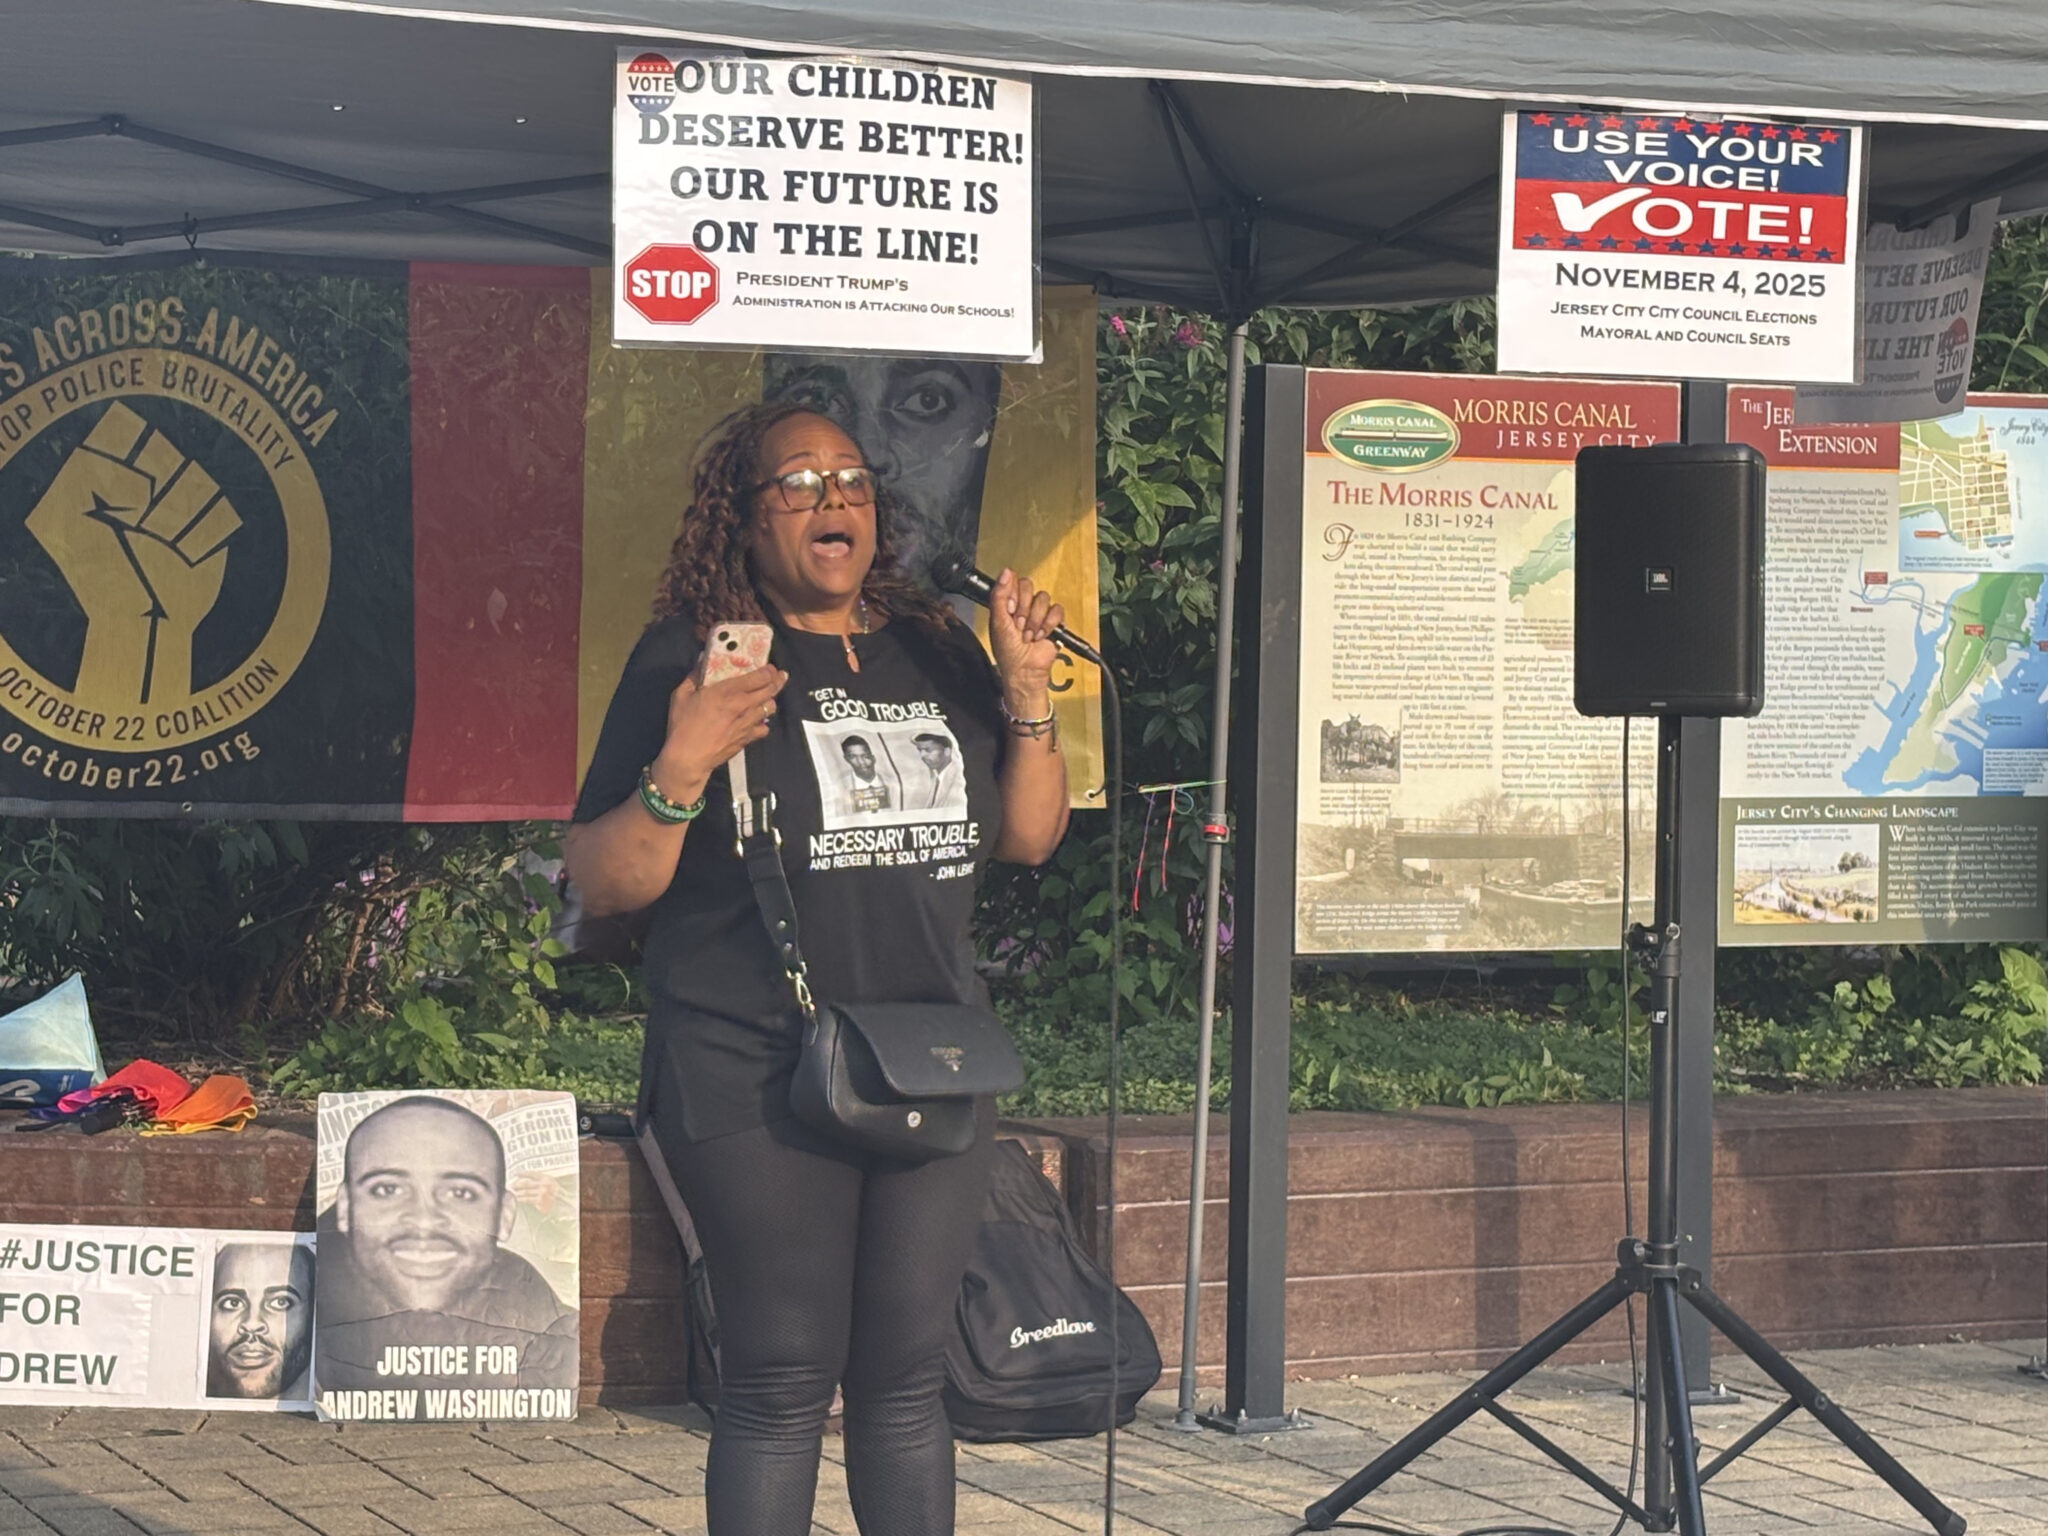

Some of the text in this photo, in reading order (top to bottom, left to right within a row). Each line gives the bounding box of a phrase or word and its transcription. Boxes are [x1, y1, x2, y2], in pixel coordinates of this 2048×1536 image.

[628, 76, 674, 92] VOTE
[674, 59, 997, 110] OUR CHILDREN
[638, 112, 1024, 165] DESERVE BETTER!
[1552, 127, 1825, 167] USE YOUR
[670, 166, 998, 214] OUR FUTURE IS
[1604, 160, 1781, 192] VOICE!
[692, 219, 979, 265] ON THE LINE!
[631, 269, 712, 299] STOP
[1722, 272, 1747, 298] 4,
[1755, 273, 1826, 297] 2025
[33, 296, 188, 373] ACROSS
[195, 306, 340, 448] AMERICA
[0, 357, 295, 471] OP POLICE BRUTALITY
[1451, 398, 1638, 429] MORRIS CANAL
[1496, 430, 1584, 449] JERSEY
[0, 657, 280, 741] OCTOBER 22 COALITION
[820, 700, 948, 722] GOOD TROUBLE,
[1, 730, 261, 790] october22.org
[809, 822, 981, 857] NECESSARY TROUBLE,
[809, 857, 832, 871] AND
[833, 854, 872, 869] REDEEM
[874, 852, 895, 867] THE
[896, 850, 919, 865] SOUL
[919, 848, 931, 862] OF
[509, 1115, 573, 1138] JEROME
[0, 1239, 195, 1278] #JUSTICE
[0, 1292, 81, 1326] FOR
[1009, 1318, 1097, 1349] Breedlove
[0, 1352, 118, 1386] DREW
[376, 1345, 518, 1376] JUSTICE FOR
[322, 1388, 571, 1420] ANDREW WASHINGTON
